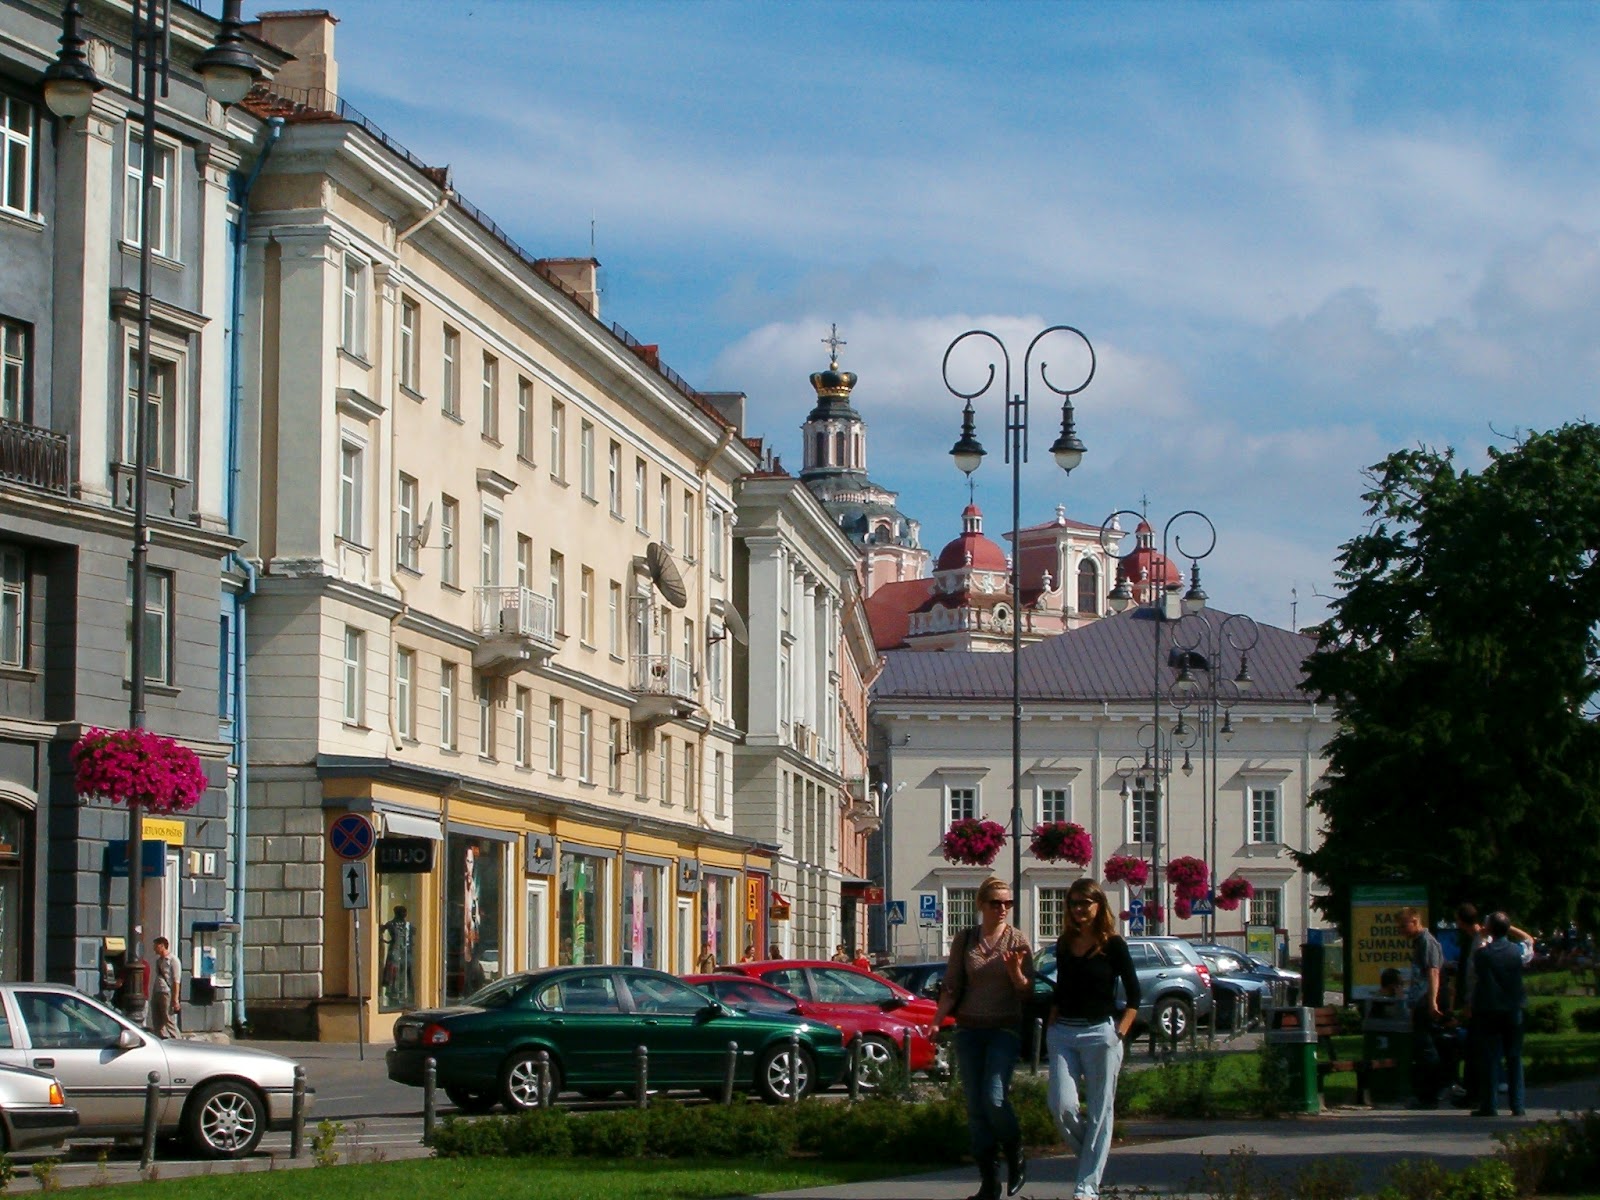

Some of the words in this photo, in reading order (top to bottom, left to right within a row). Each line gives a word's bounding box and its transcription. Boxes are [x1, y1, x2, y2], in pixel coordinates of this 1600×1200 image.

[923, 896, 933, 909] P
[1371, 926, 1400, 936] DIRB
[1359, 939, 1416, 949] SUMANU
[1359, 952, 1413, 962] LYDERIA
